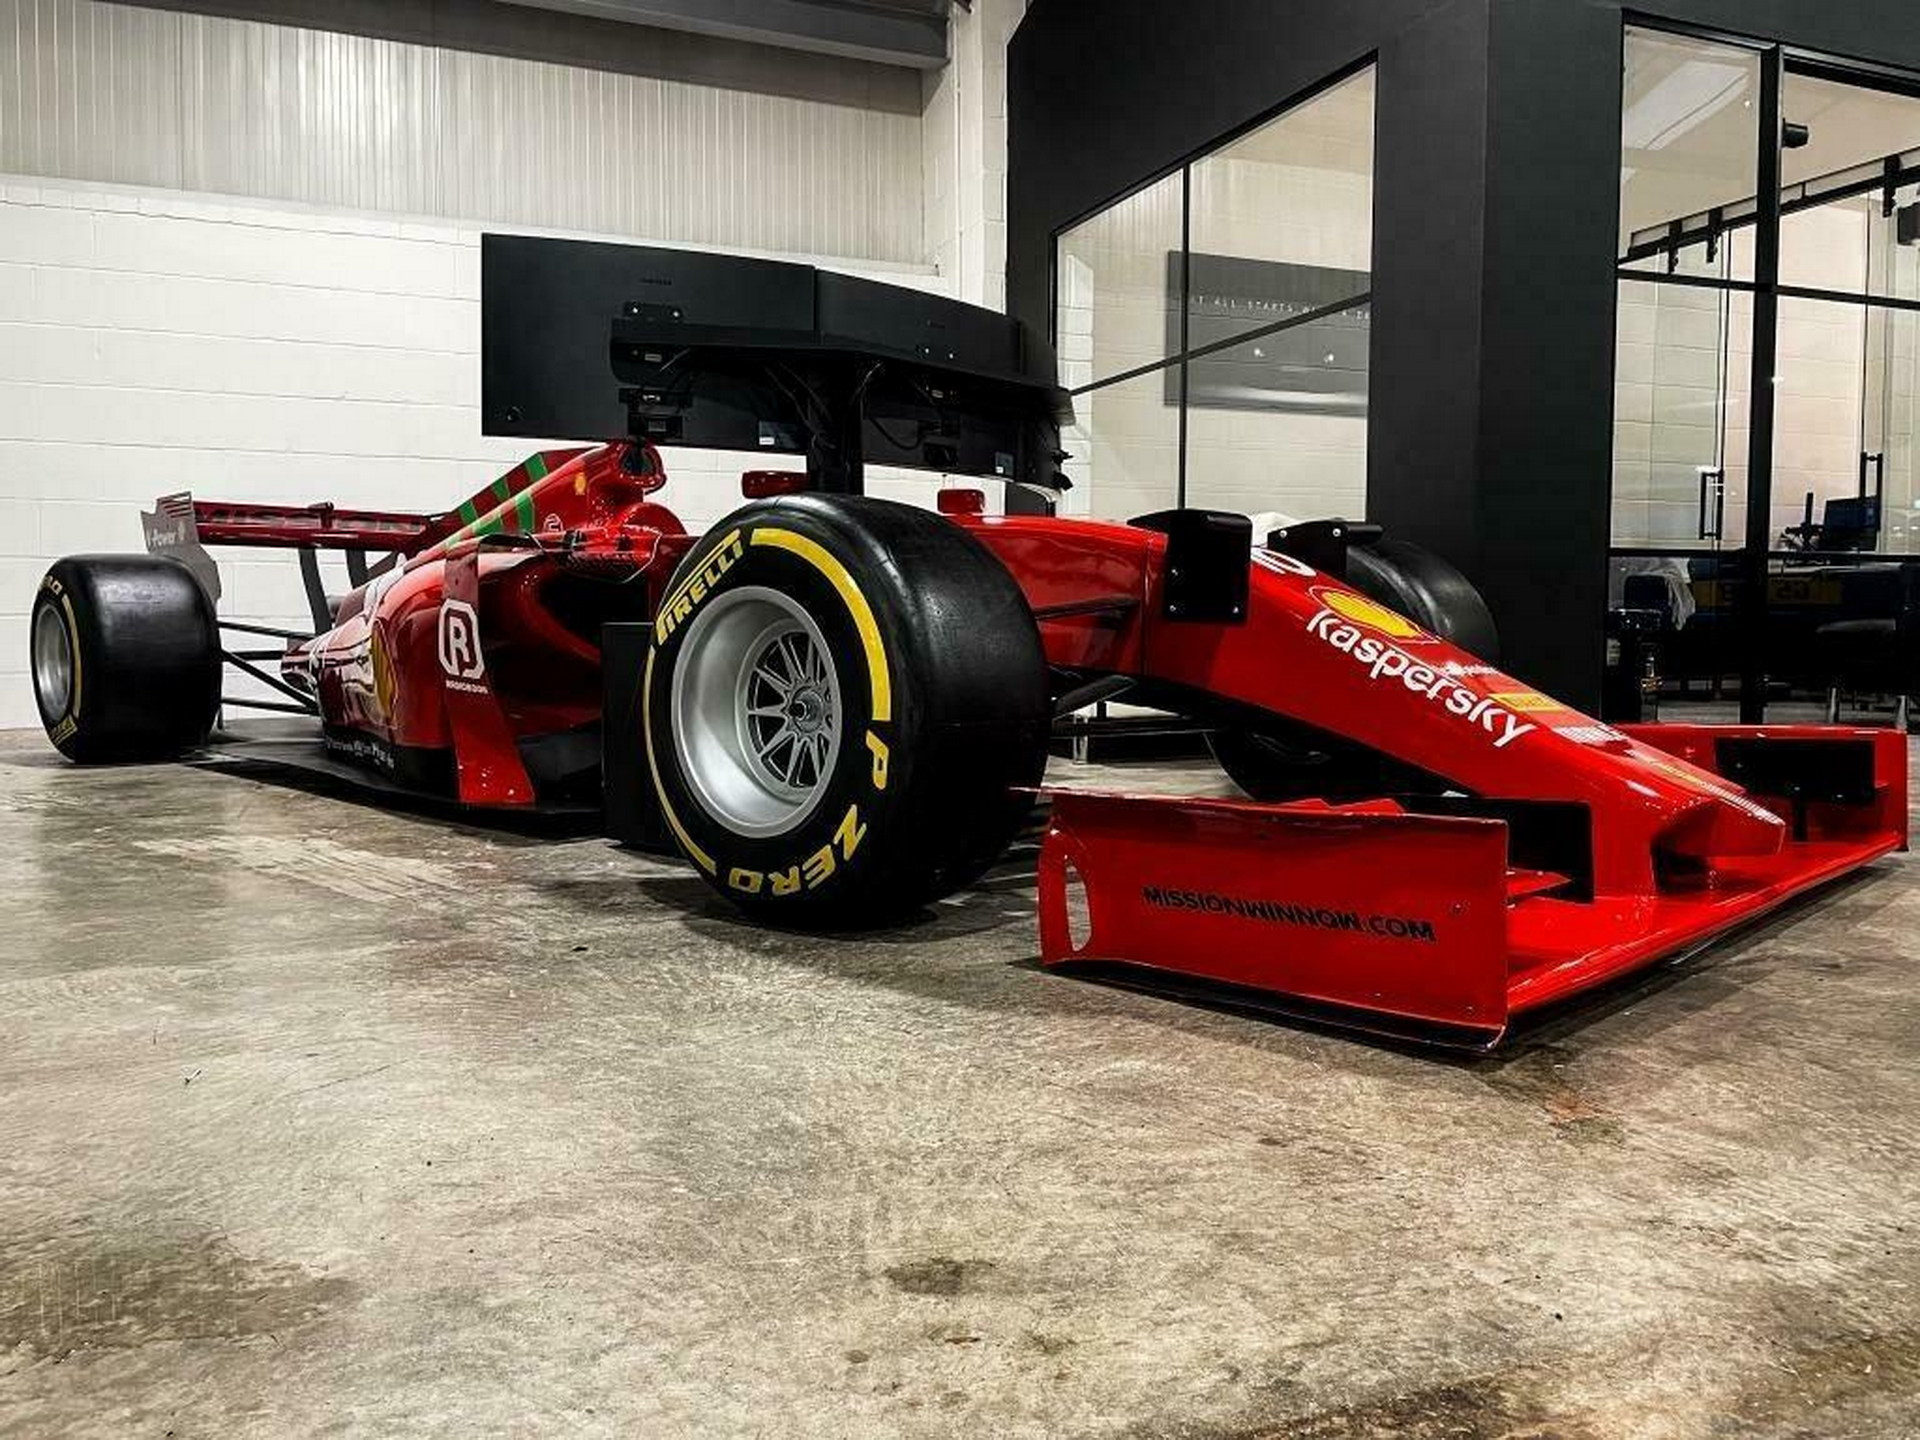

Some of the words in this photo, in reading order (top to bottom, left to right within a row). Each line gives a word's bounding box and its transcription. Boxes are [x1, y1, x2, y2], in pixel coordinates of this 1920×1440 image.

[1247, 300, 1294, 313] STARTS
[654, 528, 744, 646] PIRELLI
[1306, 607, 1538, 747] kaspersky
[865, 729, 890, 790] P
[728, 803, 868, 896] ZERO
[1142, 886, 1437, 942] MISSIONWINNOW.COM
